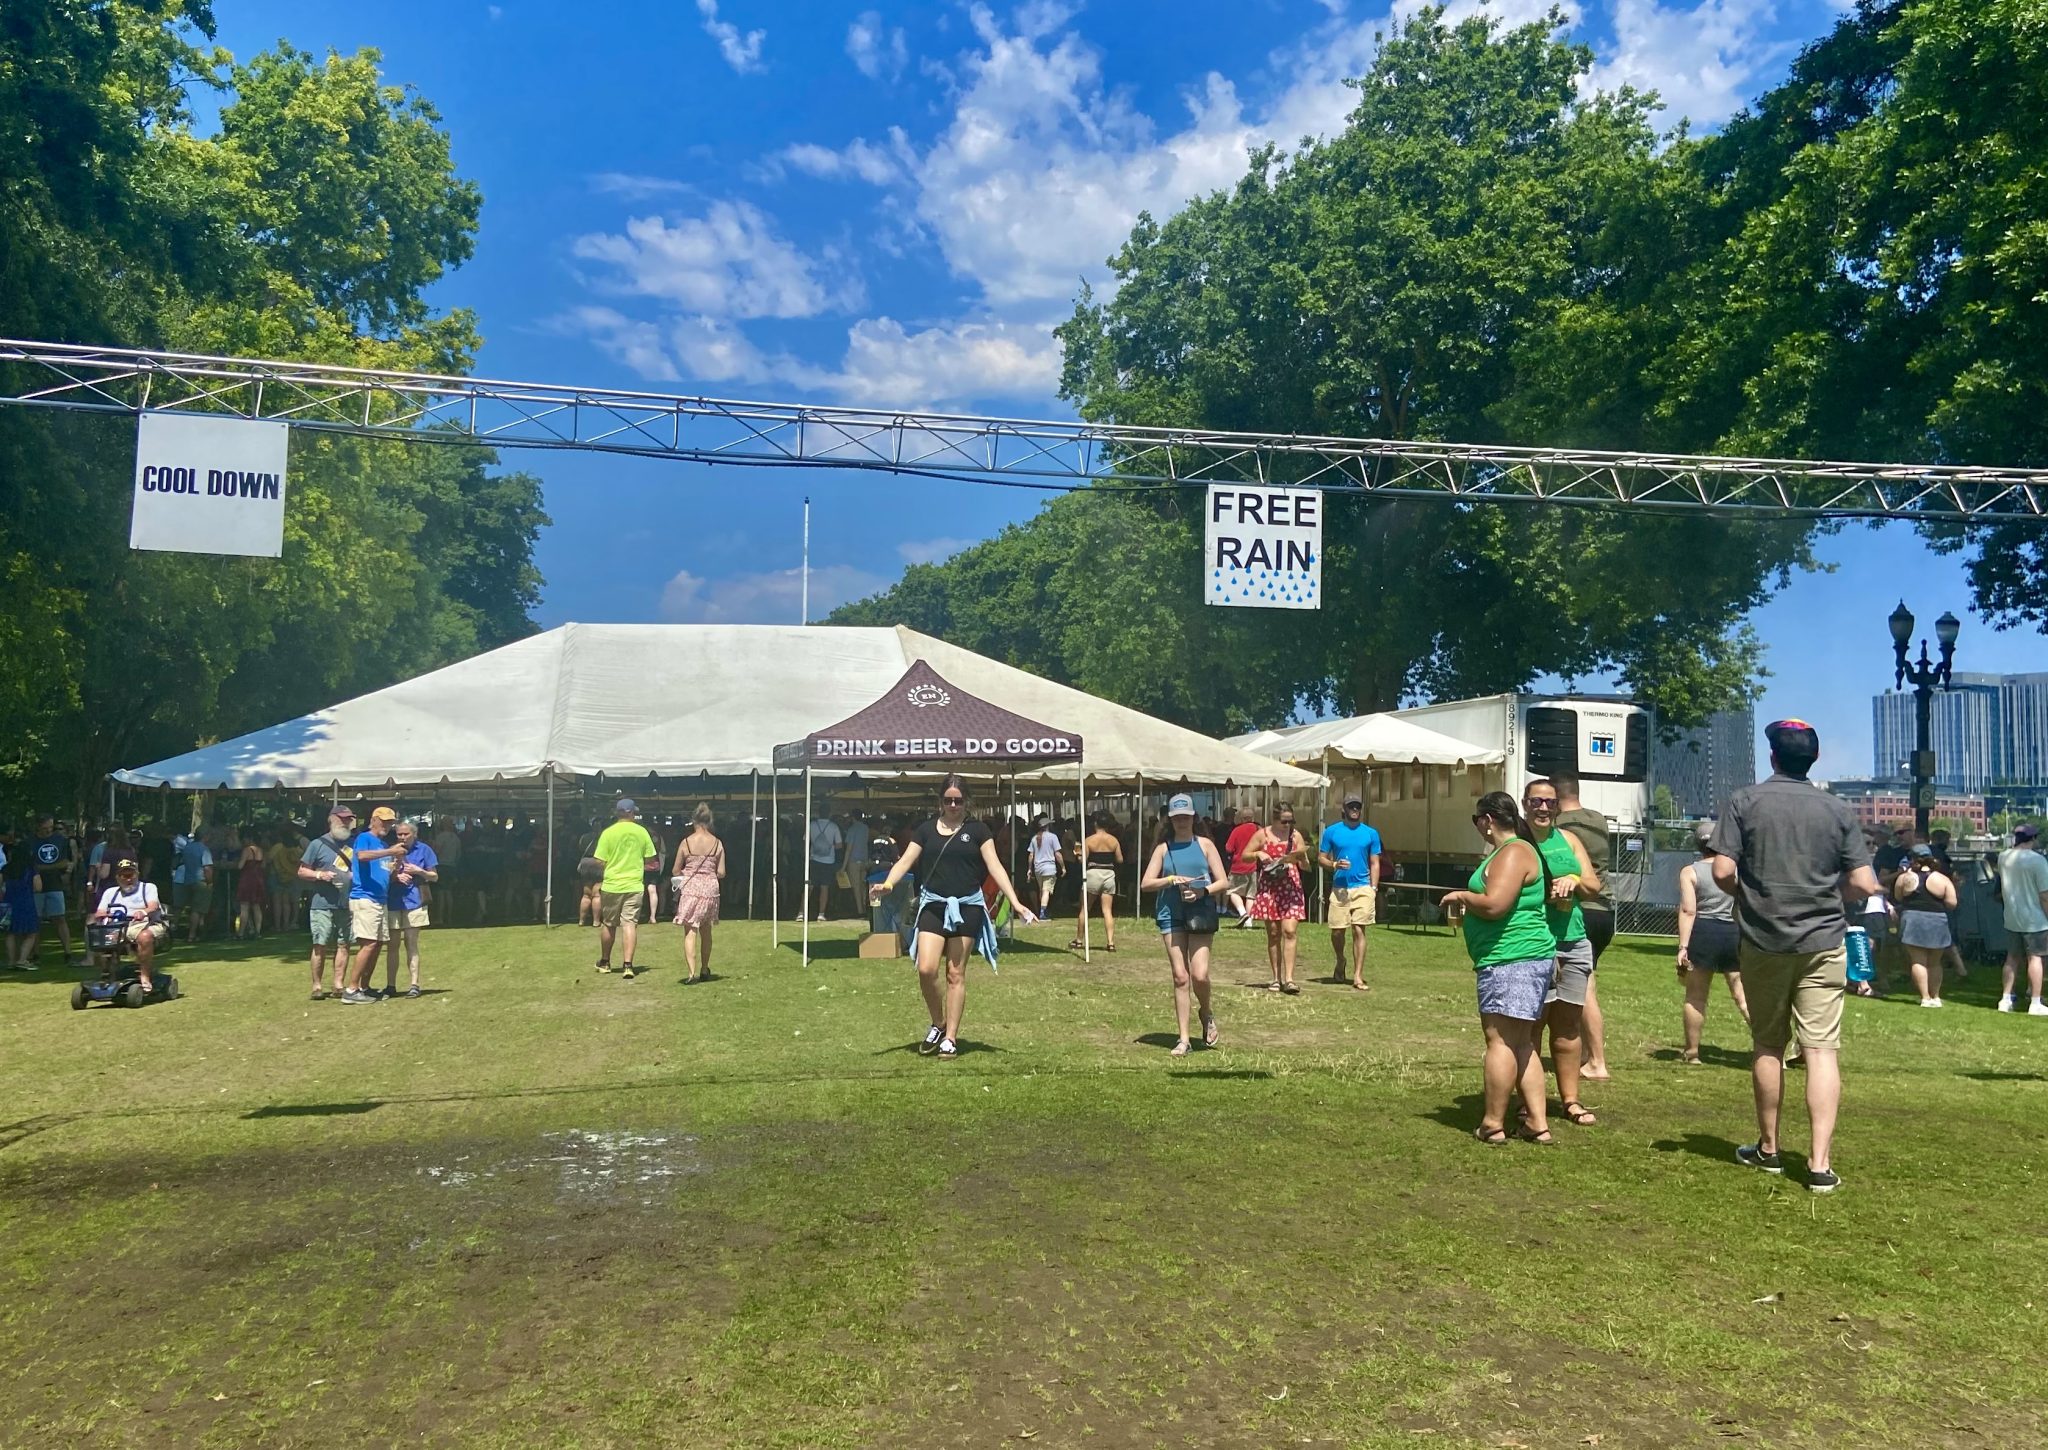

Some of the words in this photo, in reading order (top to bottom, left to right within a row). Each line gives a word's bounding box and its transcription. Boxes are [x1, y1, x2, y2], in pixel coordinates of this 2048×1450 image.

[142, 466, 199, 495] COOL
[207, 470, 280, 500] DOWN
[1213, 492, 1317, 528] FREE
[1217, 537, 1311, 572] RAIN
[816, 739, 886, 756] DRINK
[894, 738, 958, 754] BEER.
[965, 738, 998, 754] DO
[1006, 737, 1077, 754] GOOD.
